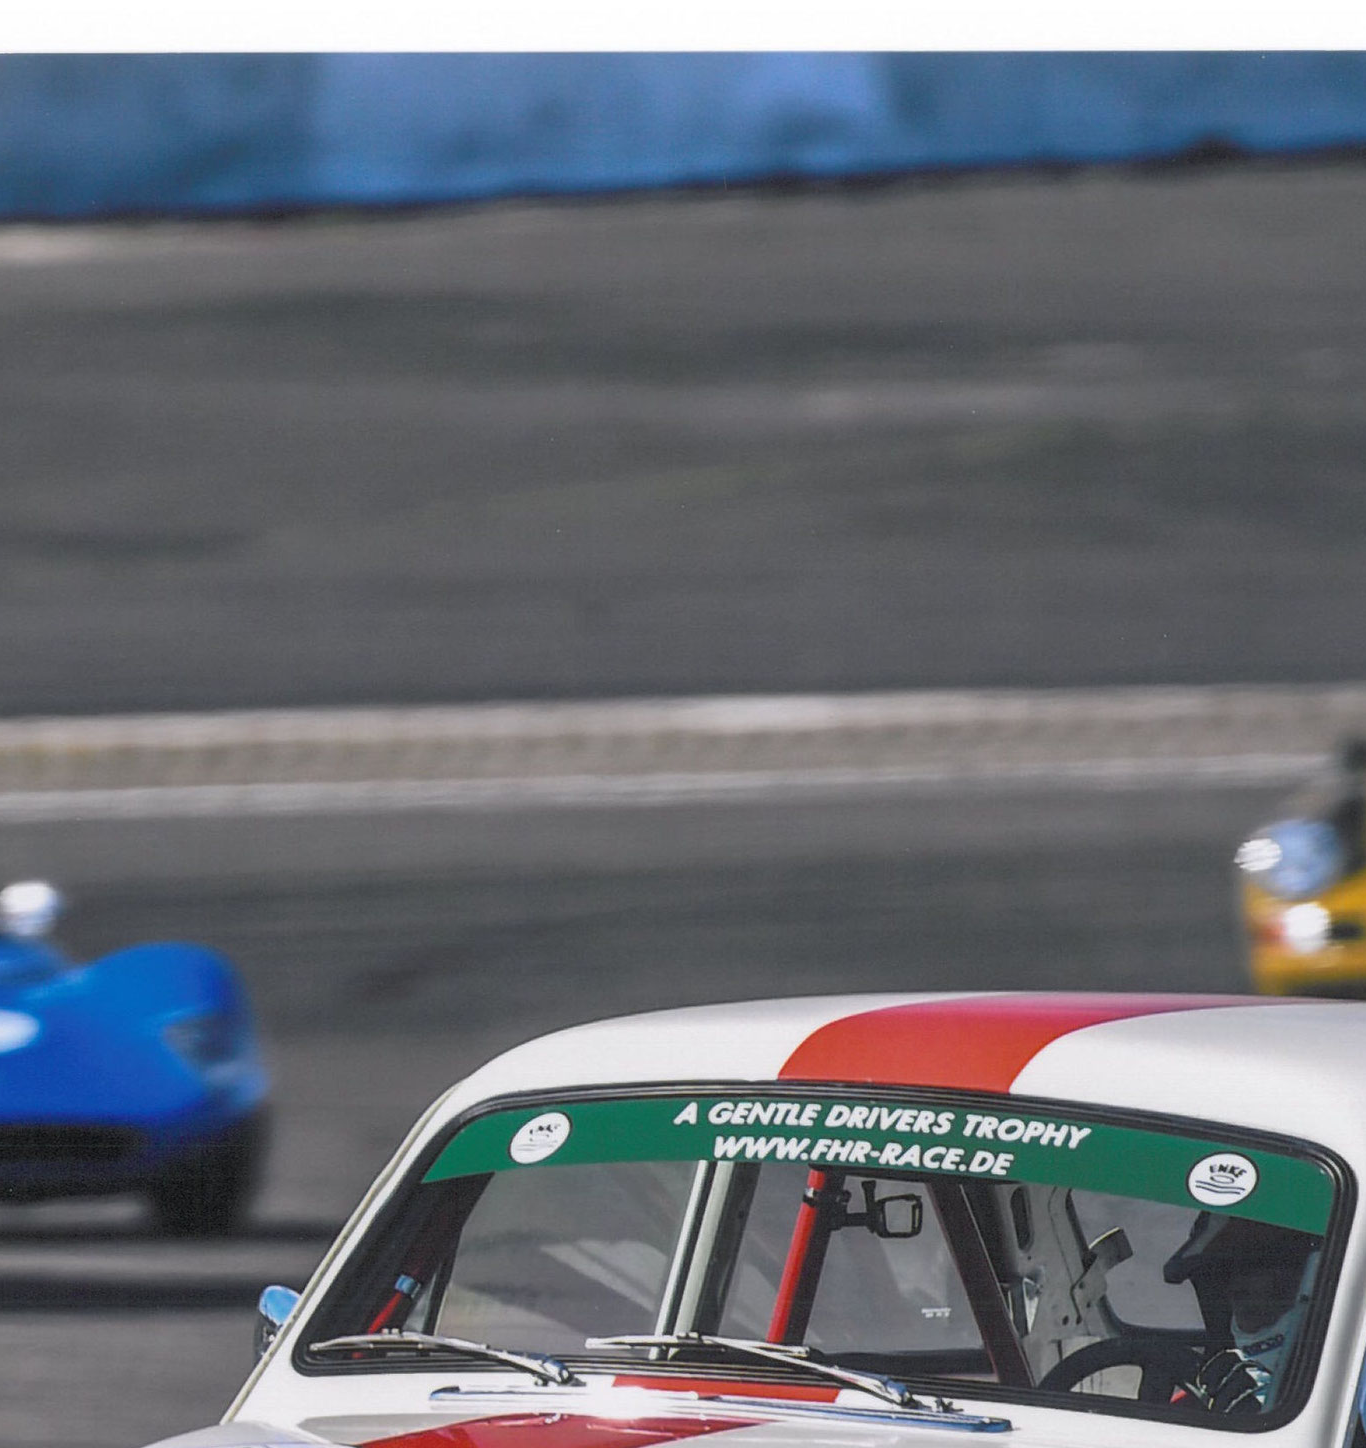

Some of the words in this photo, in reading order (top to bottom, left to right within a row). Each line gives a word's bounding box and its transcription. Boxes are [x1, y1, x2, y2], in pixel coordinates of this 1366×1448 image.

[673, 1101, 699, 1126] A
[707, 1101, 822, 1127] GENTLE
[824, 1104, 956, 1136] DRIVERS
[962, 1113, 1092, 1150] TROPHY
[713, 1135, 1015, 1176] WWW.FHR-RACE.DE
